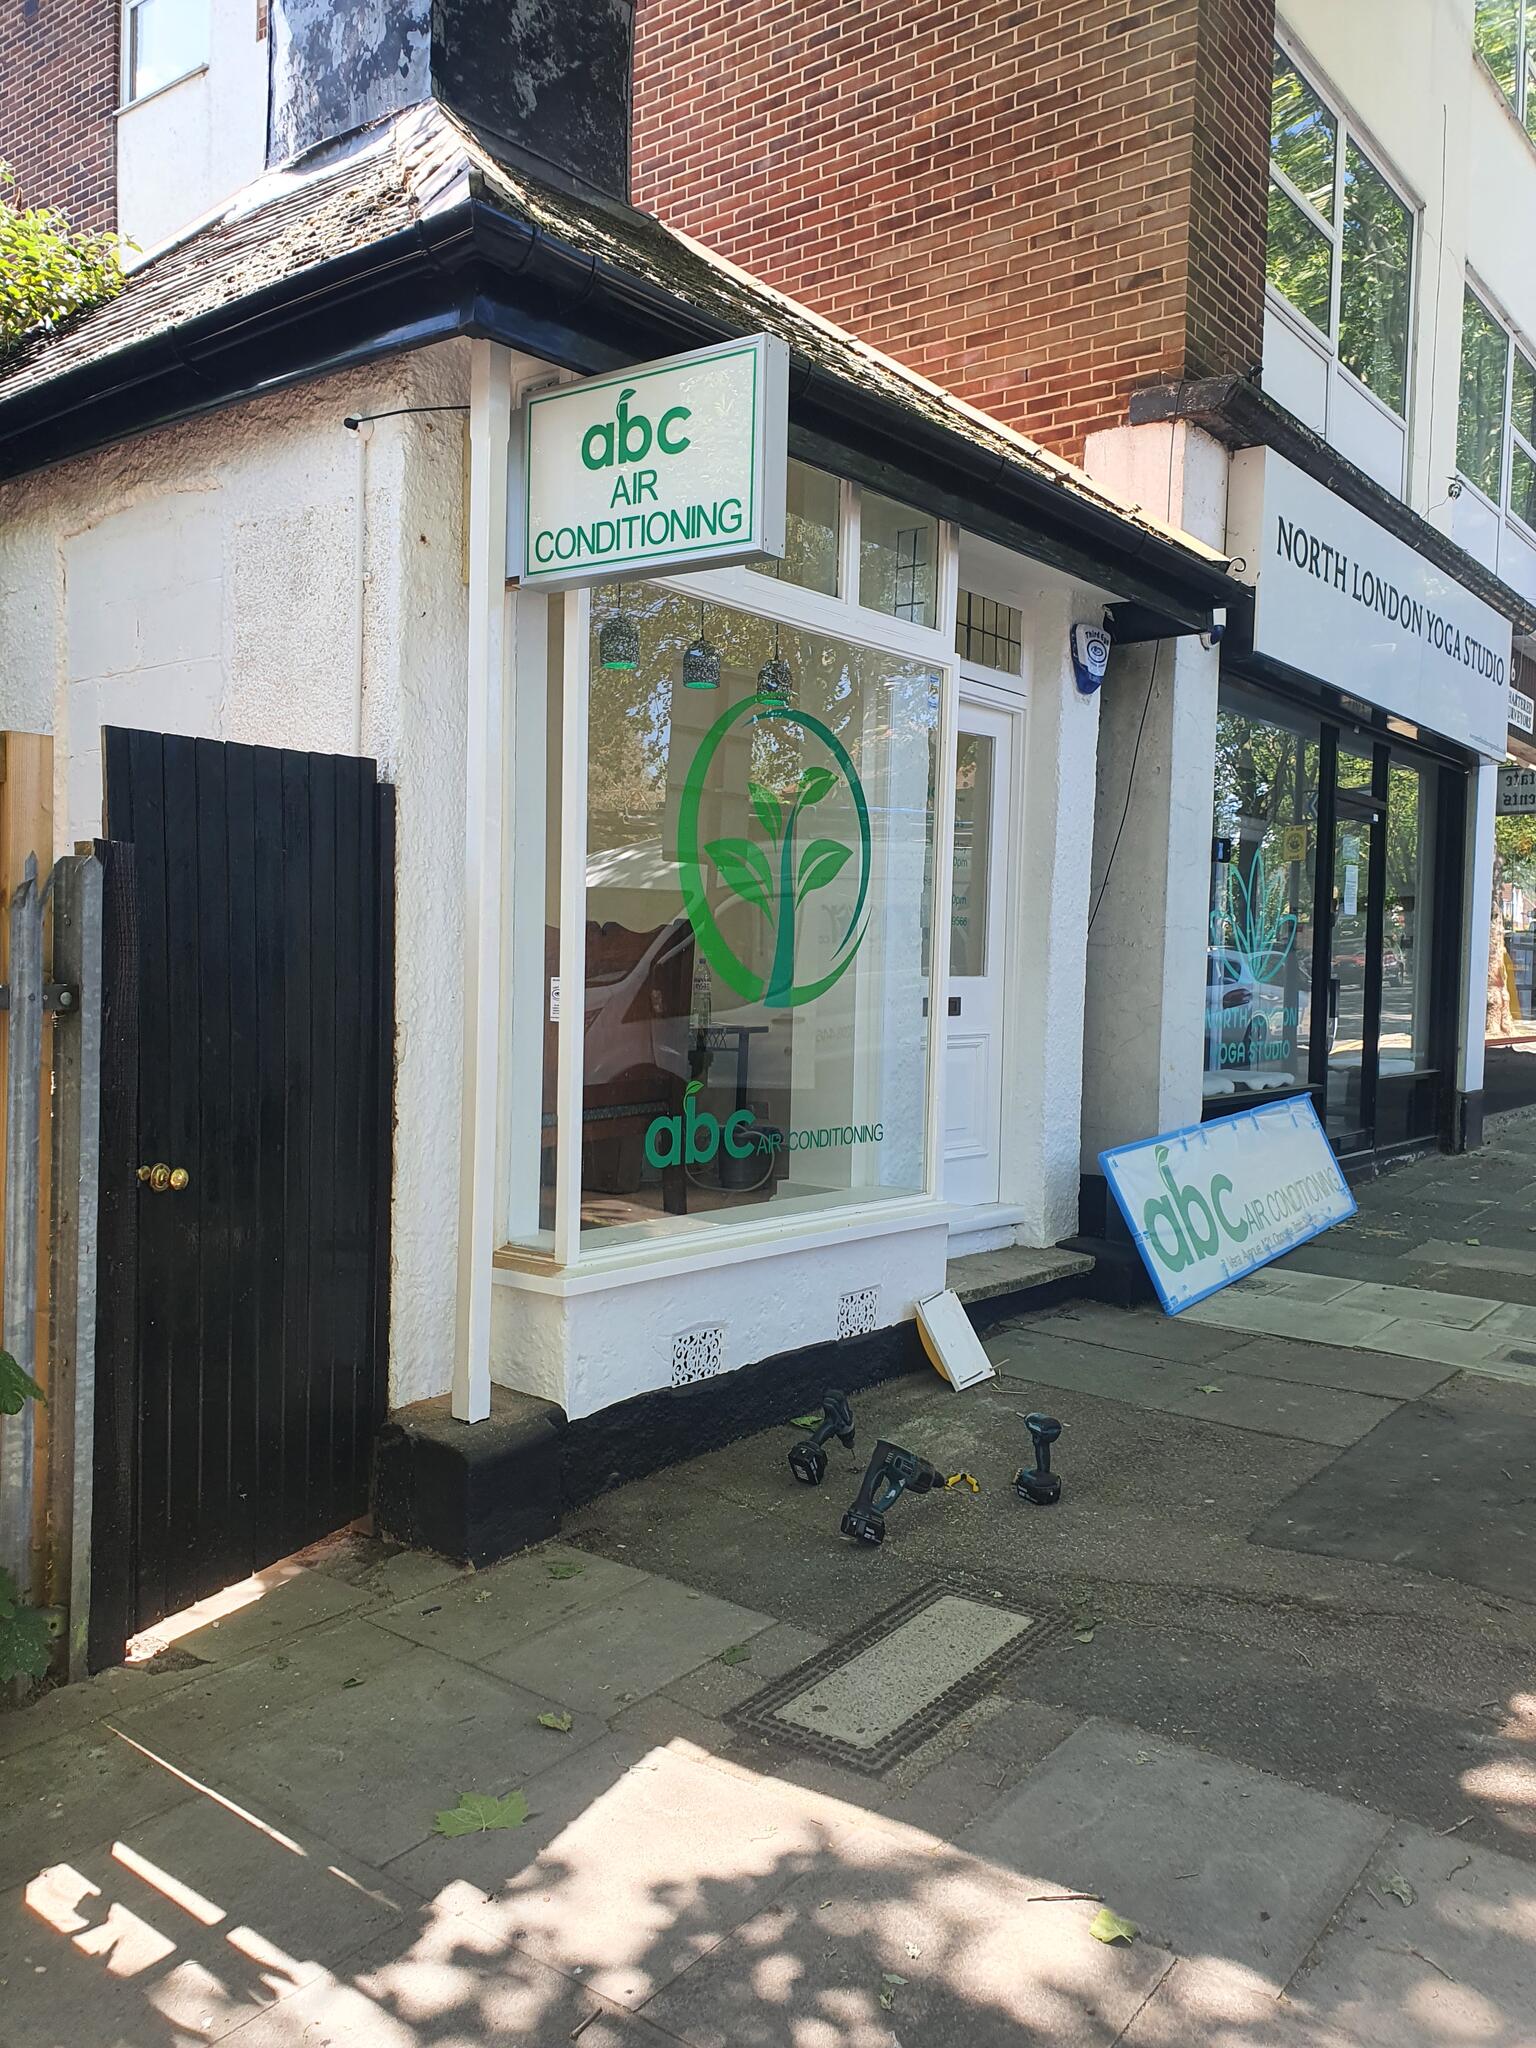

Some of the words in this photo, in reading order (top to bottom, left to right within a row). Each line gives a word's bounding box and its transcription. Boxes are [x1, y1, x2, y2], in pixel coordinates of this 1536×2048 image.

[581, 392, 692, 471] abc
[610, 469, 659, 509] AIR
[535, 498, 743, 563] CONDITIONING
[1276, 515, 1348, 593] NORTH
[1351, 563, 1423, 638] LONDON
[1426, 609, 1462, 669] YOGA
[1463, 635, 1505, 687] STUDIO
[1216, 1041, 1246, 1063] OGA
[1249, 1040, 1291, 1060] STUDIO
[645, 1082, 757, 1168] abc
[757, 1133, 783, 1156] AIR
[788, 1123, 884, 1151] CONDITIONING
[1144, 1146, 1249, 1273] abc
[1244, 1199, 1272, 1234] AIR
[1266, 1167, 1341, 1222] CONDITIONING
